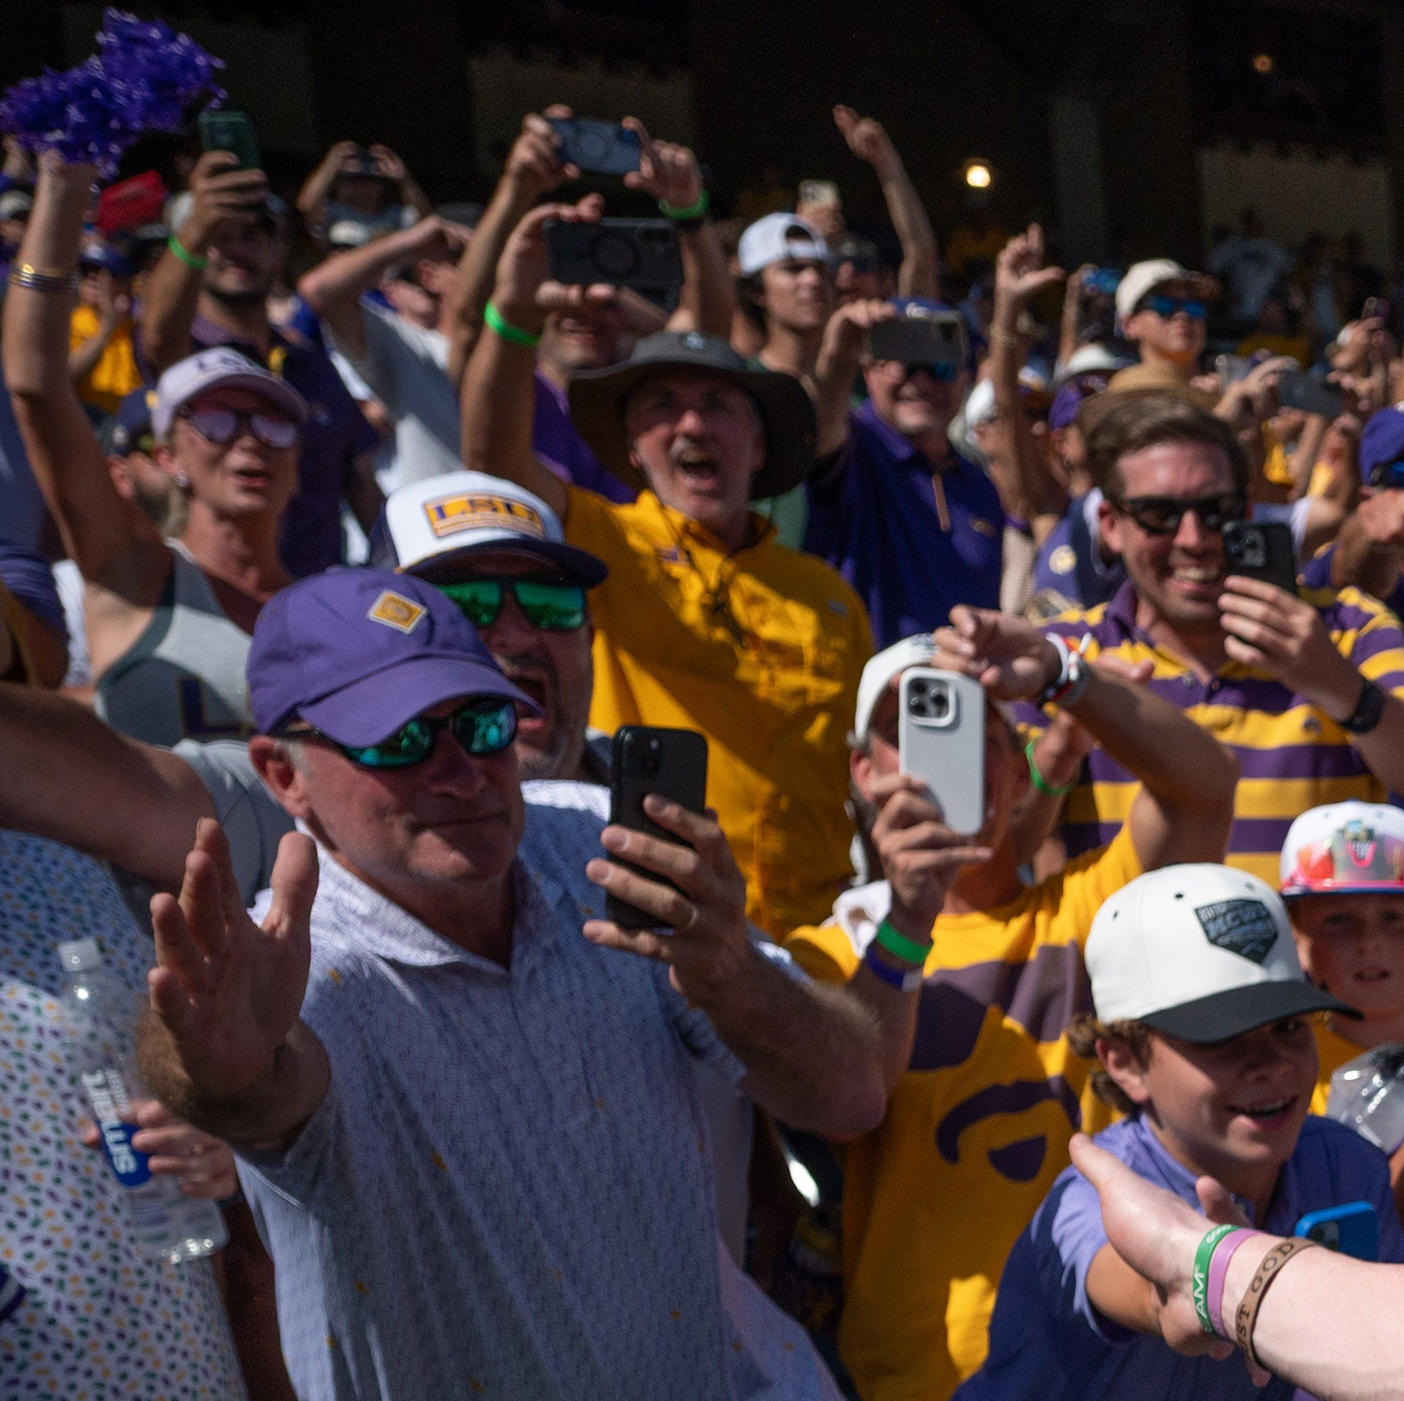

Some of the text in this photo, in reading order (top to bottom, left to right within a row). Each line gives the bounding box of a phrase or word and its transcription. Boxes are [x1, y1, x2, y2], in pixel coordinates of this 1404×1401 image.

[433, 498, 546, 522] LSU
[81, 1068, 138, 1175] smart
[1251, 1242, 1294, 1293] GOD
